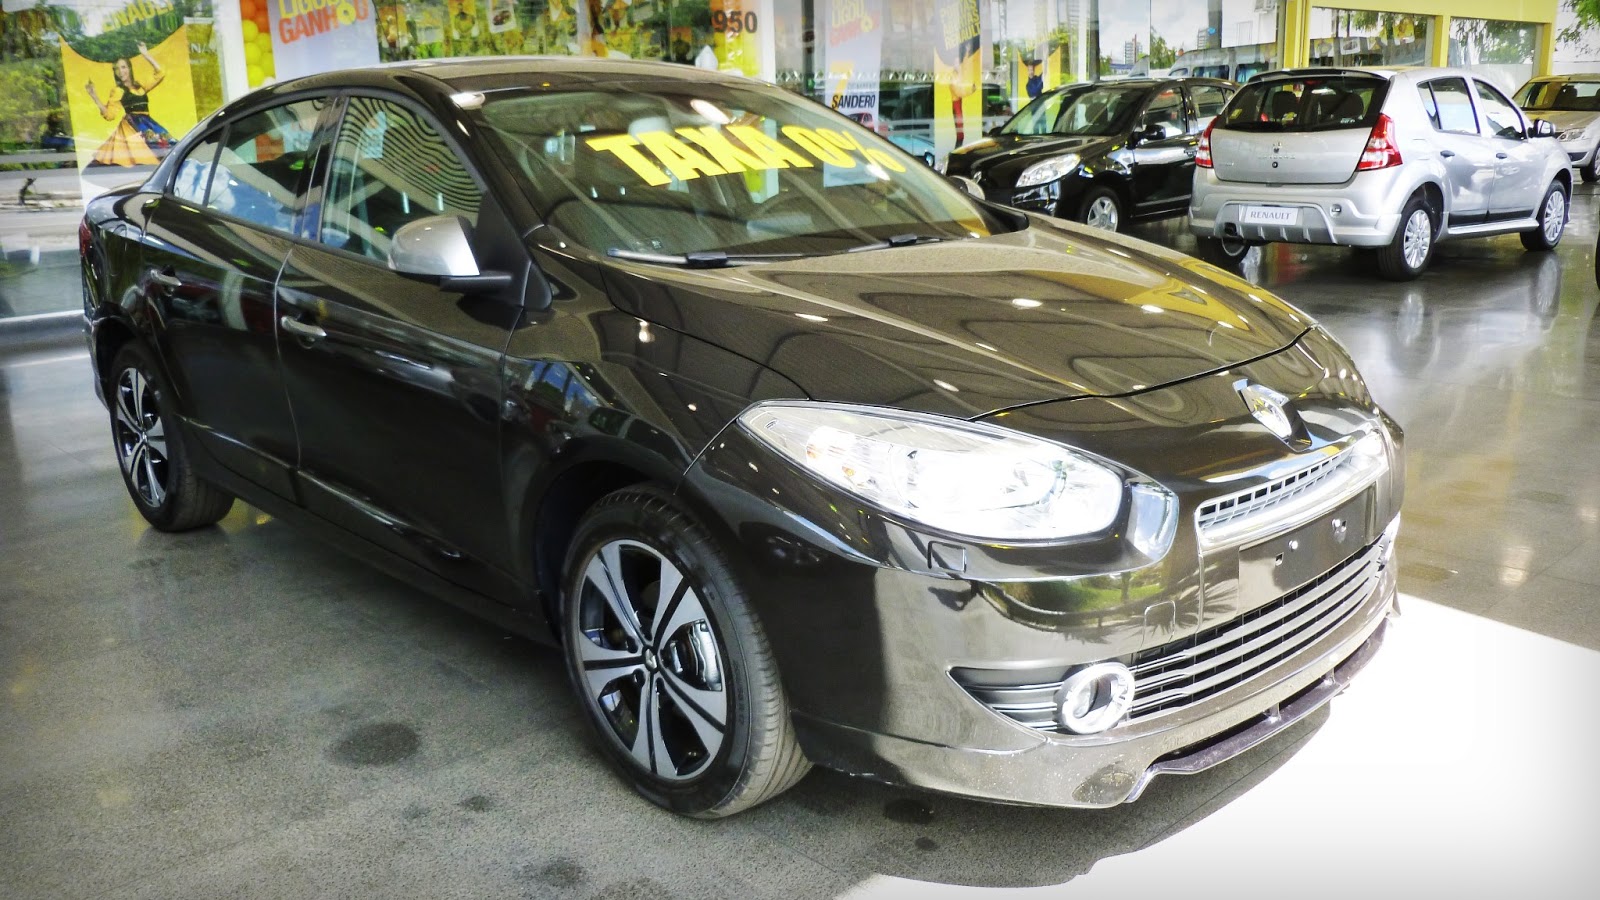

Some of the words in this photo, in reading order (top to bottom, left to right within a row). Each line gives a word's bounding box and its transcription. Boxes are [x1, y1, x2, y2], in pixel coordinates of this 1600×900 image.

[713, 10, 758, 33] 950
[832, 94, 876, 109] SANDERO
[585, 126, 814, 186] TAXA
[781, 125, 906, 173] 0%
[1250, 210, 1292, 220] RENAULT
